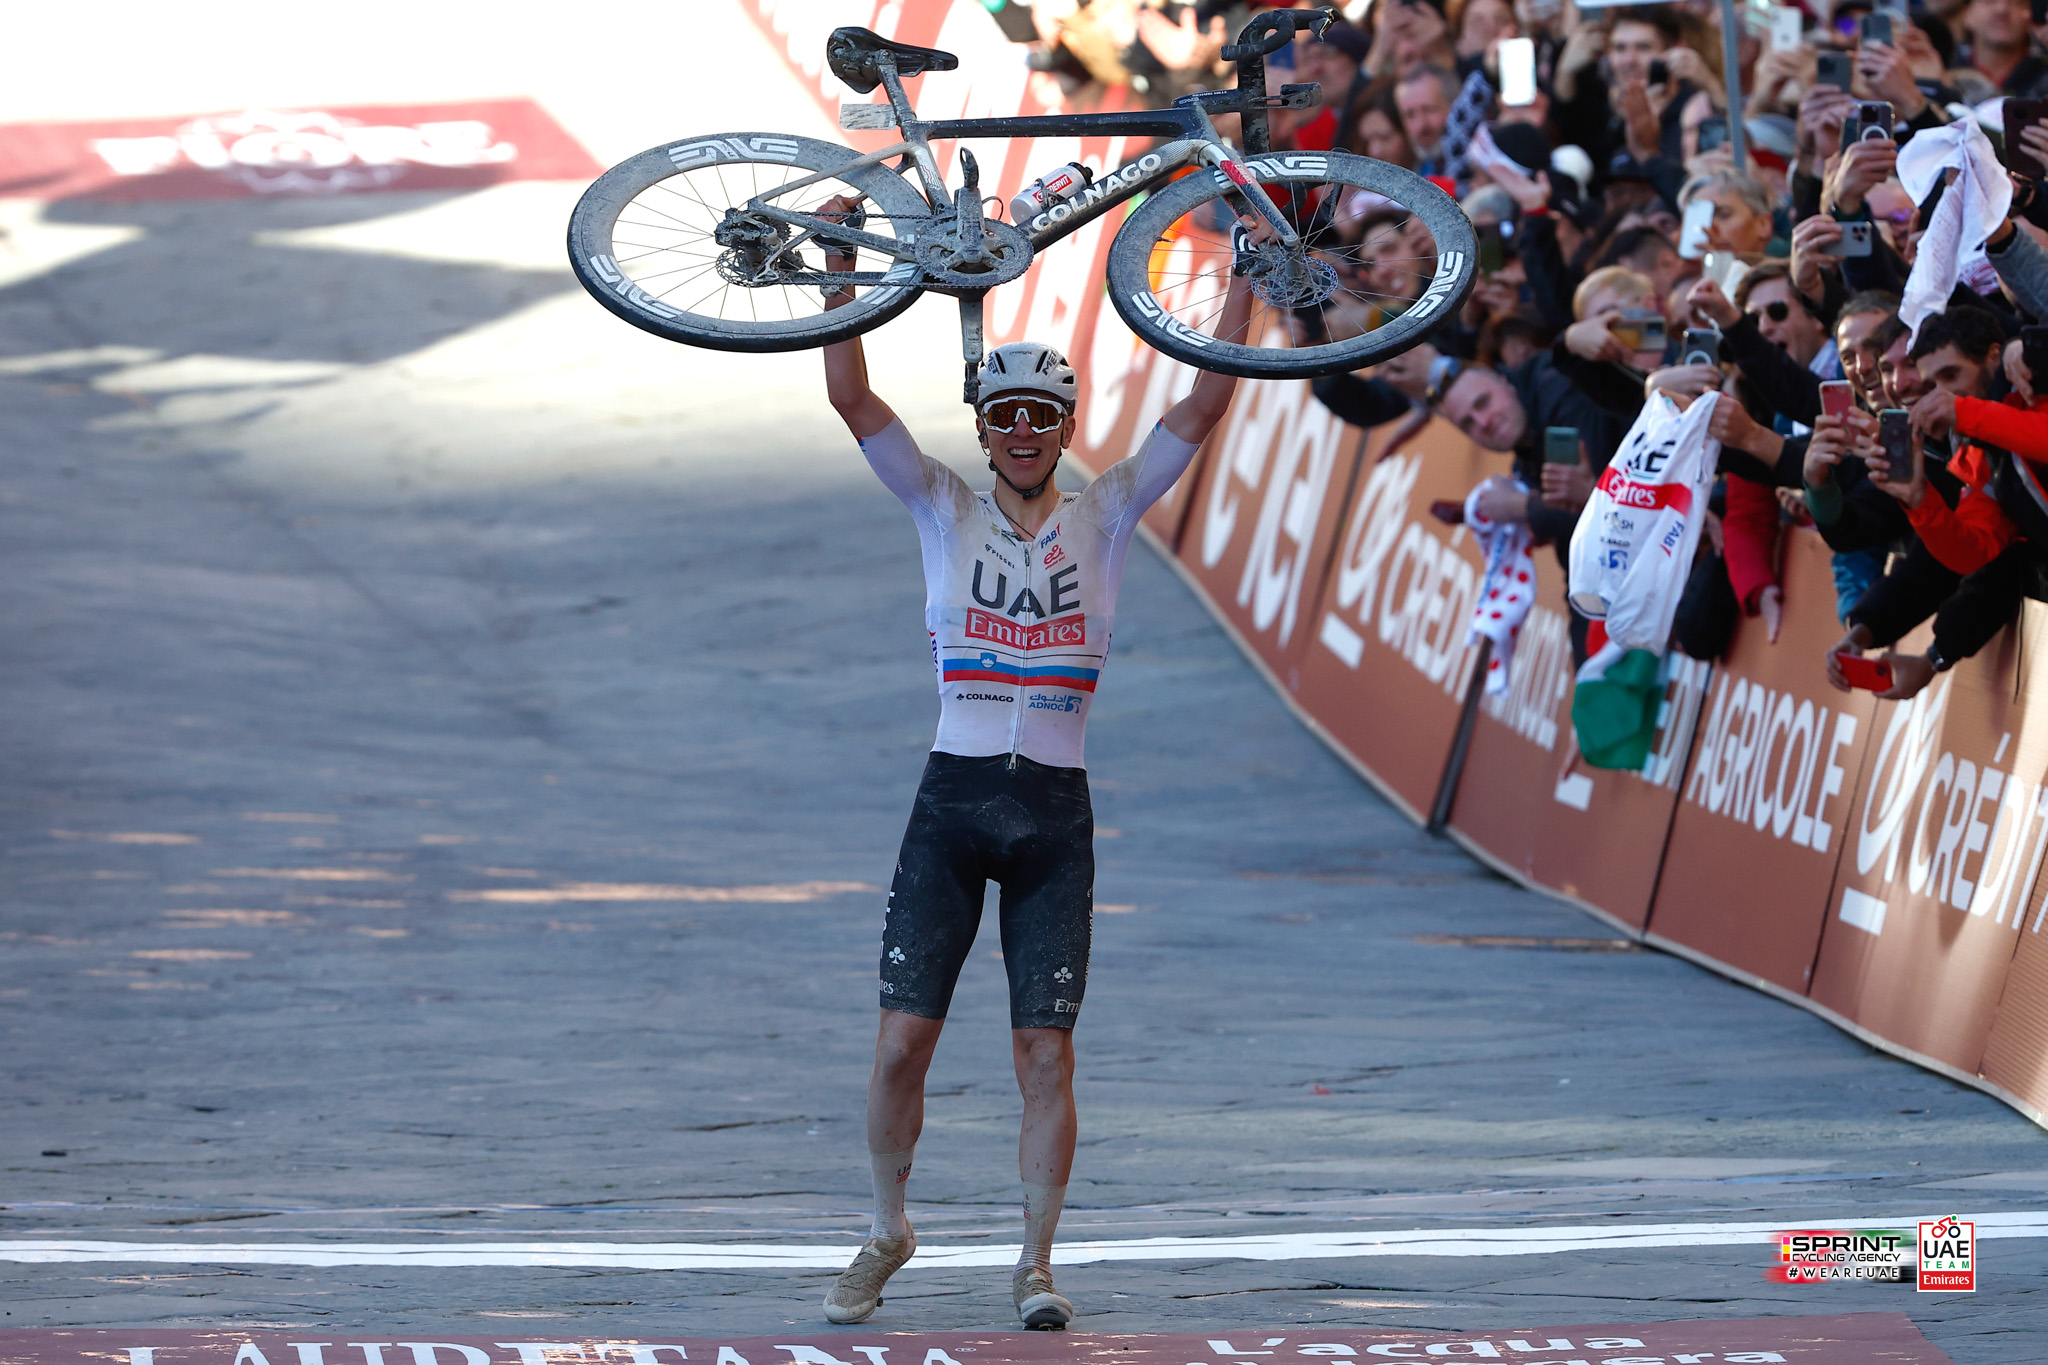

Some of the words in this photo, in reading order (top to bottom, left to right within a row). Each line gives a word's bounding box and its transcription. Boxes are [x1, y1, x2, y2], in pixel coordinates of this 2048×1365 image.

[1031, 153, 1162, 232] COLNAGO
[987, 351, 1000, 375] MET
[1042, 350, 1057, 376] MET
[991, 549, 1015, 570] PISSEI
[971, 559, 1080, 620] UAE
[970, 612, 1083, 647] Emirates
[965, 693, 1014, 703] COLNAGO
[1028, 702, 1065, 711] ADNOC
[1686, 671, 1858, 854] AGRICOLE
[1206, 1336, 1648, 1358] L'acqua
